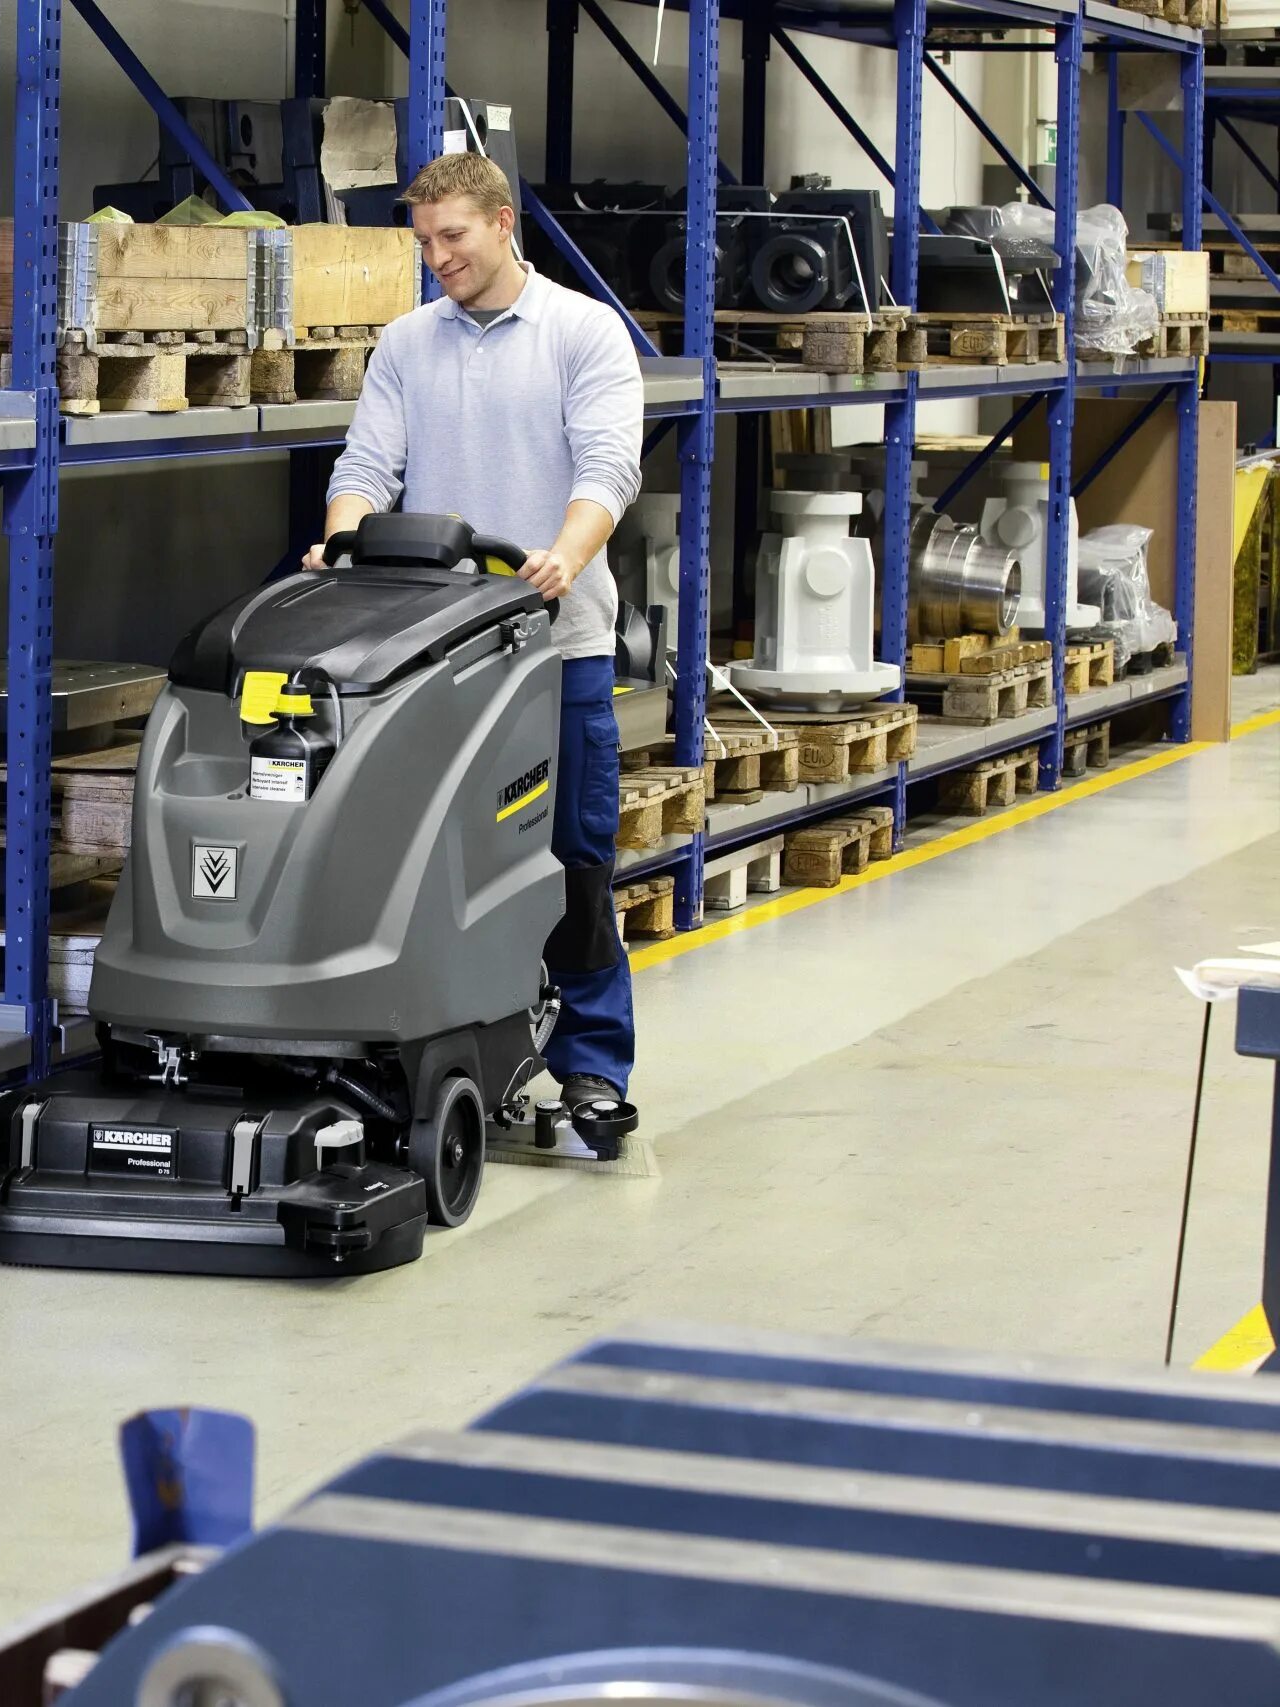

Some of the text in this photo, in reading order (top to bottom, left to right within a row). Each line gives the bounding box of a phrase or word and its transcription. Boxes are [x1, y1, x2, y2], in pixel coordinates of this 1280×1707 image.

[504, 759, 549, 805] KÄRCHER
[518, 805, 549, 835] Professional
[104, 1130, 172, 1146] KÄRCHER
[127, 1157, 171, 1168] Professional
